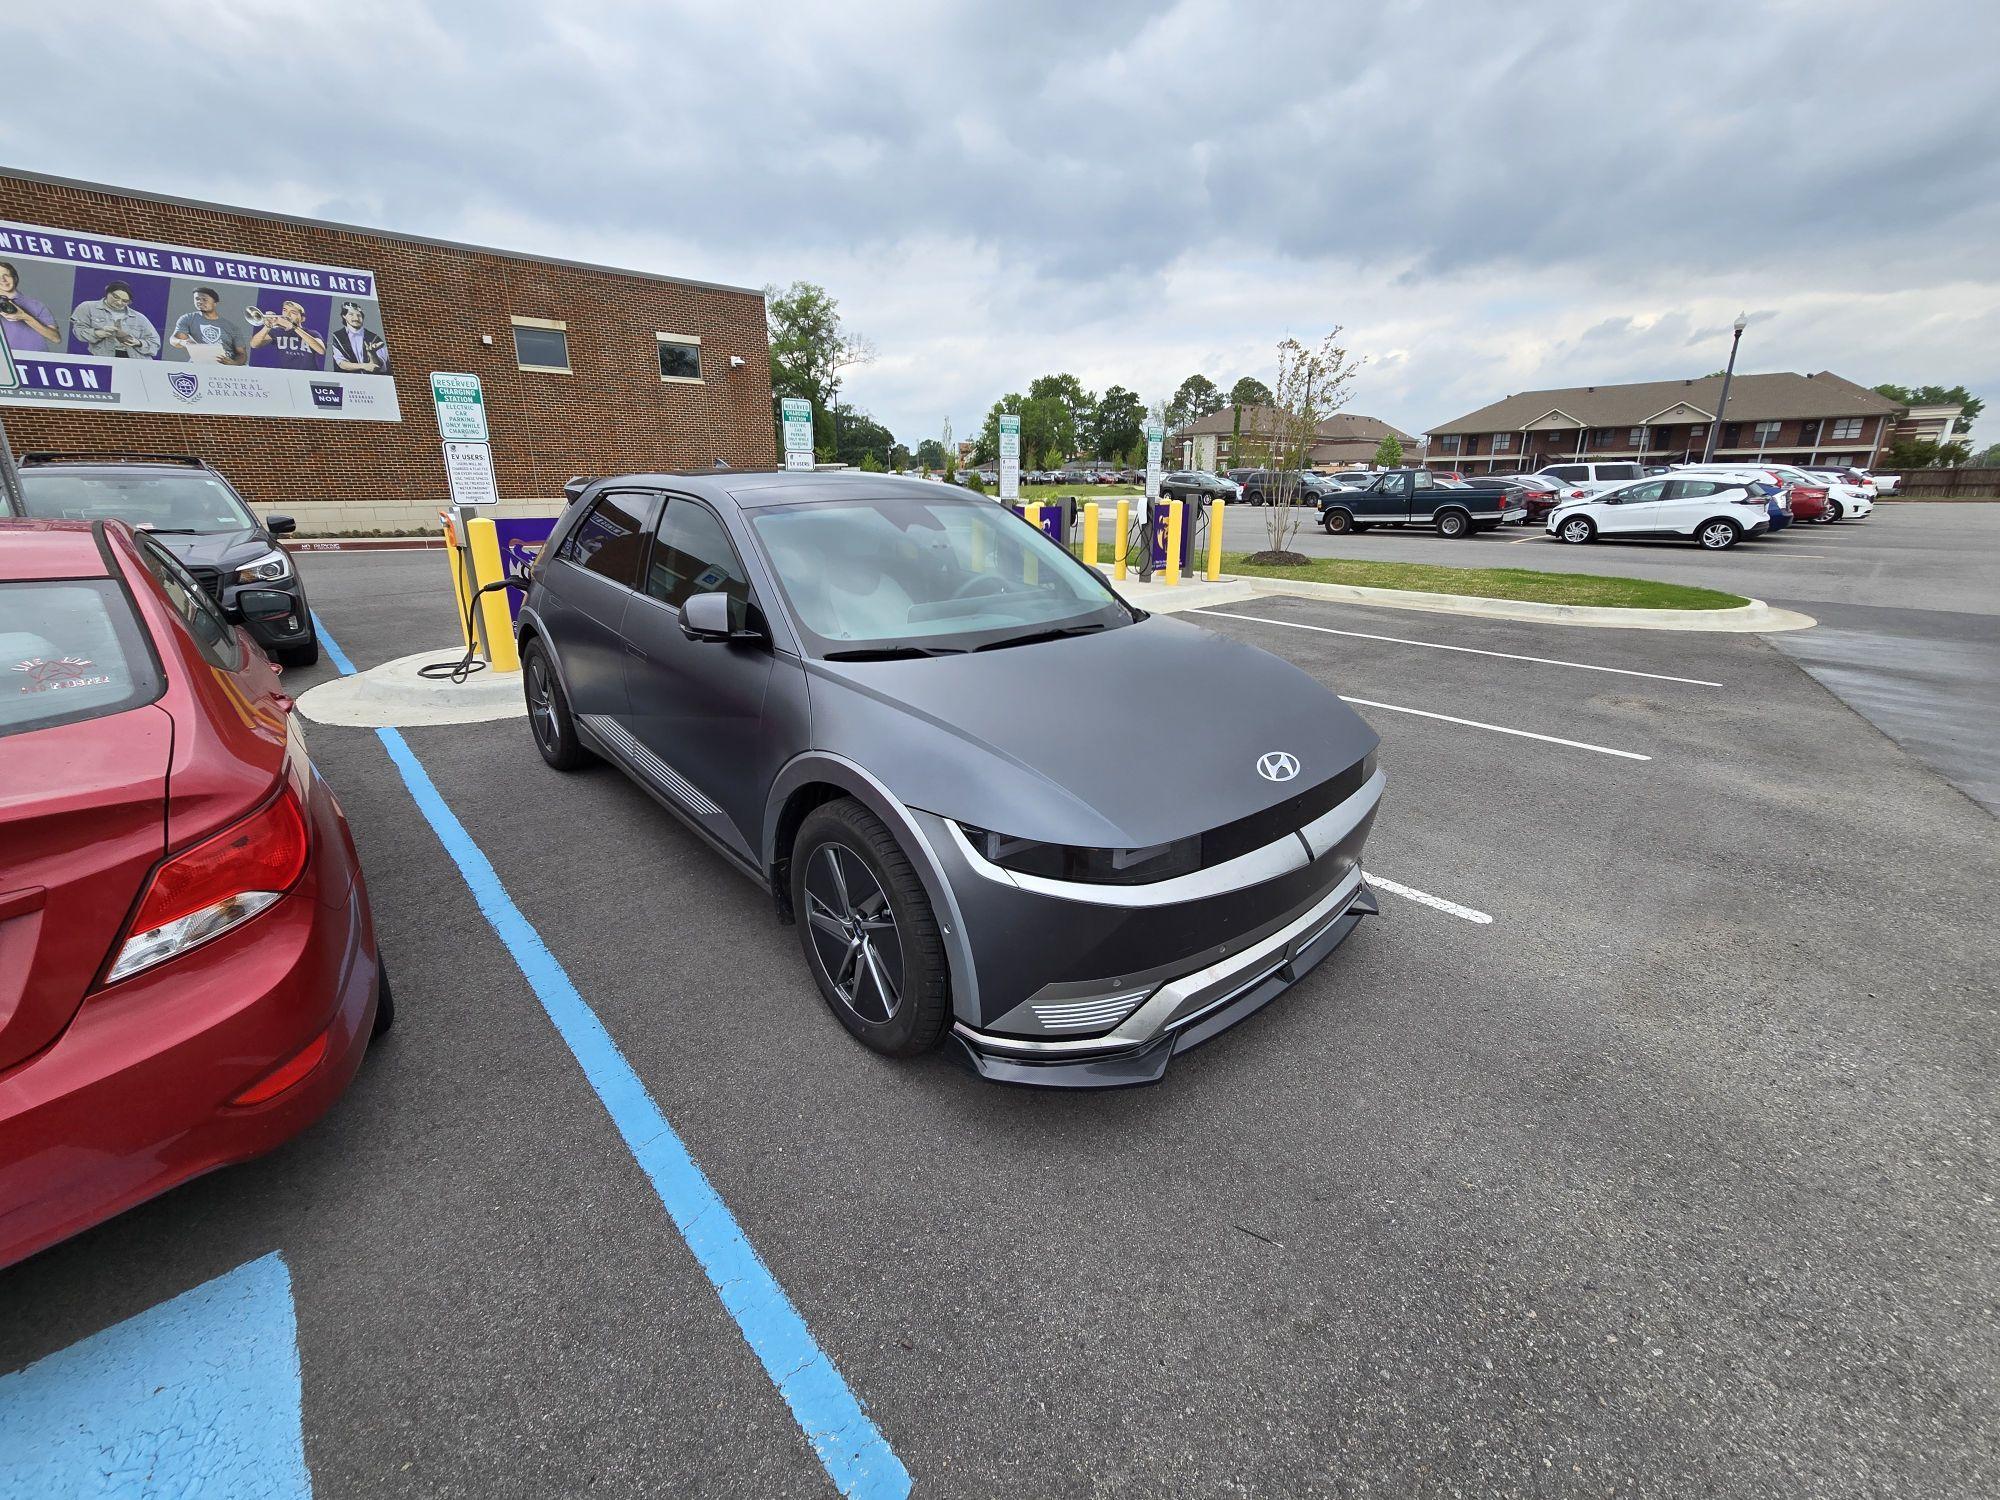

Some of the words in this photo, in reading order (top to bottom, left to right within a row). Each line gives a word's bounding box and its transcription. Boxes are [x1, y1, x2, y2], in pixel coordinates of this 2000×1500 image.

[0, 233, 54, 255] NTER
[64, 241, 106, 262] FOR
[115, 248, 161, 268] FINE
[171, 255, 206, 274] AND
[215, 261, 320, 287] PERFORMING
[329, 275, 367, 293] ARTS
[276, 336, 313, 353] UCA
[15, 364, 99, 389] TION
[208, 381, 263, 391] CENTRAL
[436, 379, 475, 388] RESERVED
[63, 392, 114, 400] ARKANSAS
[207, 389, 269, 398] ARKANSAS
[439, 387, 476, 396] CHARGING
[318, 395, 340, 403] NOW
[444, 395, 474, 403] STATION
